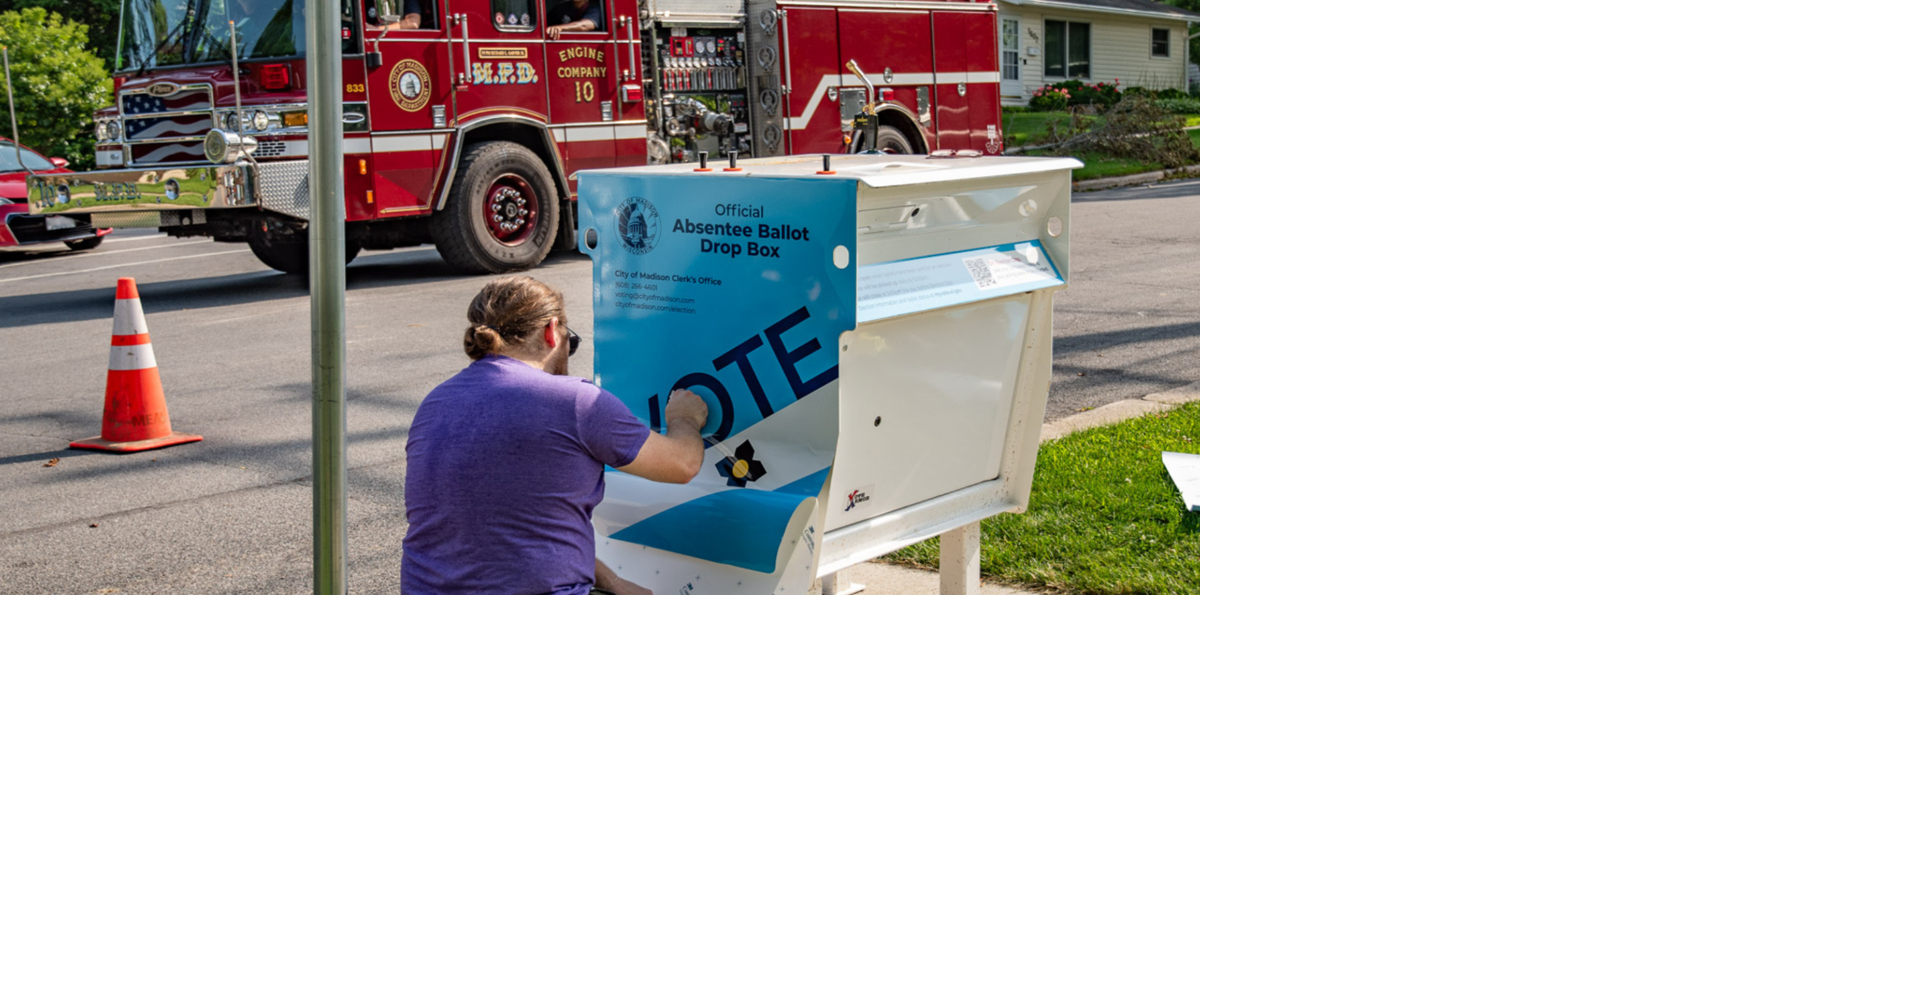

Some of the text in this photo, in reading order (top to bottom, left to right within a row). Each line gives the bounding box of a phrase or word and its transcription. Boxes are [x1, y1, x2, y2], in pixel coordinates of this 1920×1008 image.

[558, 47, 605, 62] ENGINE
[472, 62, 539, 85] M.F.D.
[557, 67, 607, 78] COMPANY
[346, 84, 365, 93] 833
[575, 81, 595, 103] 10
[715, 204, 764, 218] Official
[672, 219, 810, 241] Absentee Ballot
[701, 238, 780, 259] Drop Box
[615, 270, 629, 279] City
[639, 272, 671, 281] Madison
[672, 274, 697, 283] Clerk's
[698, 277, 722, 286] Office
[648, 305, 839, 450] OTE
